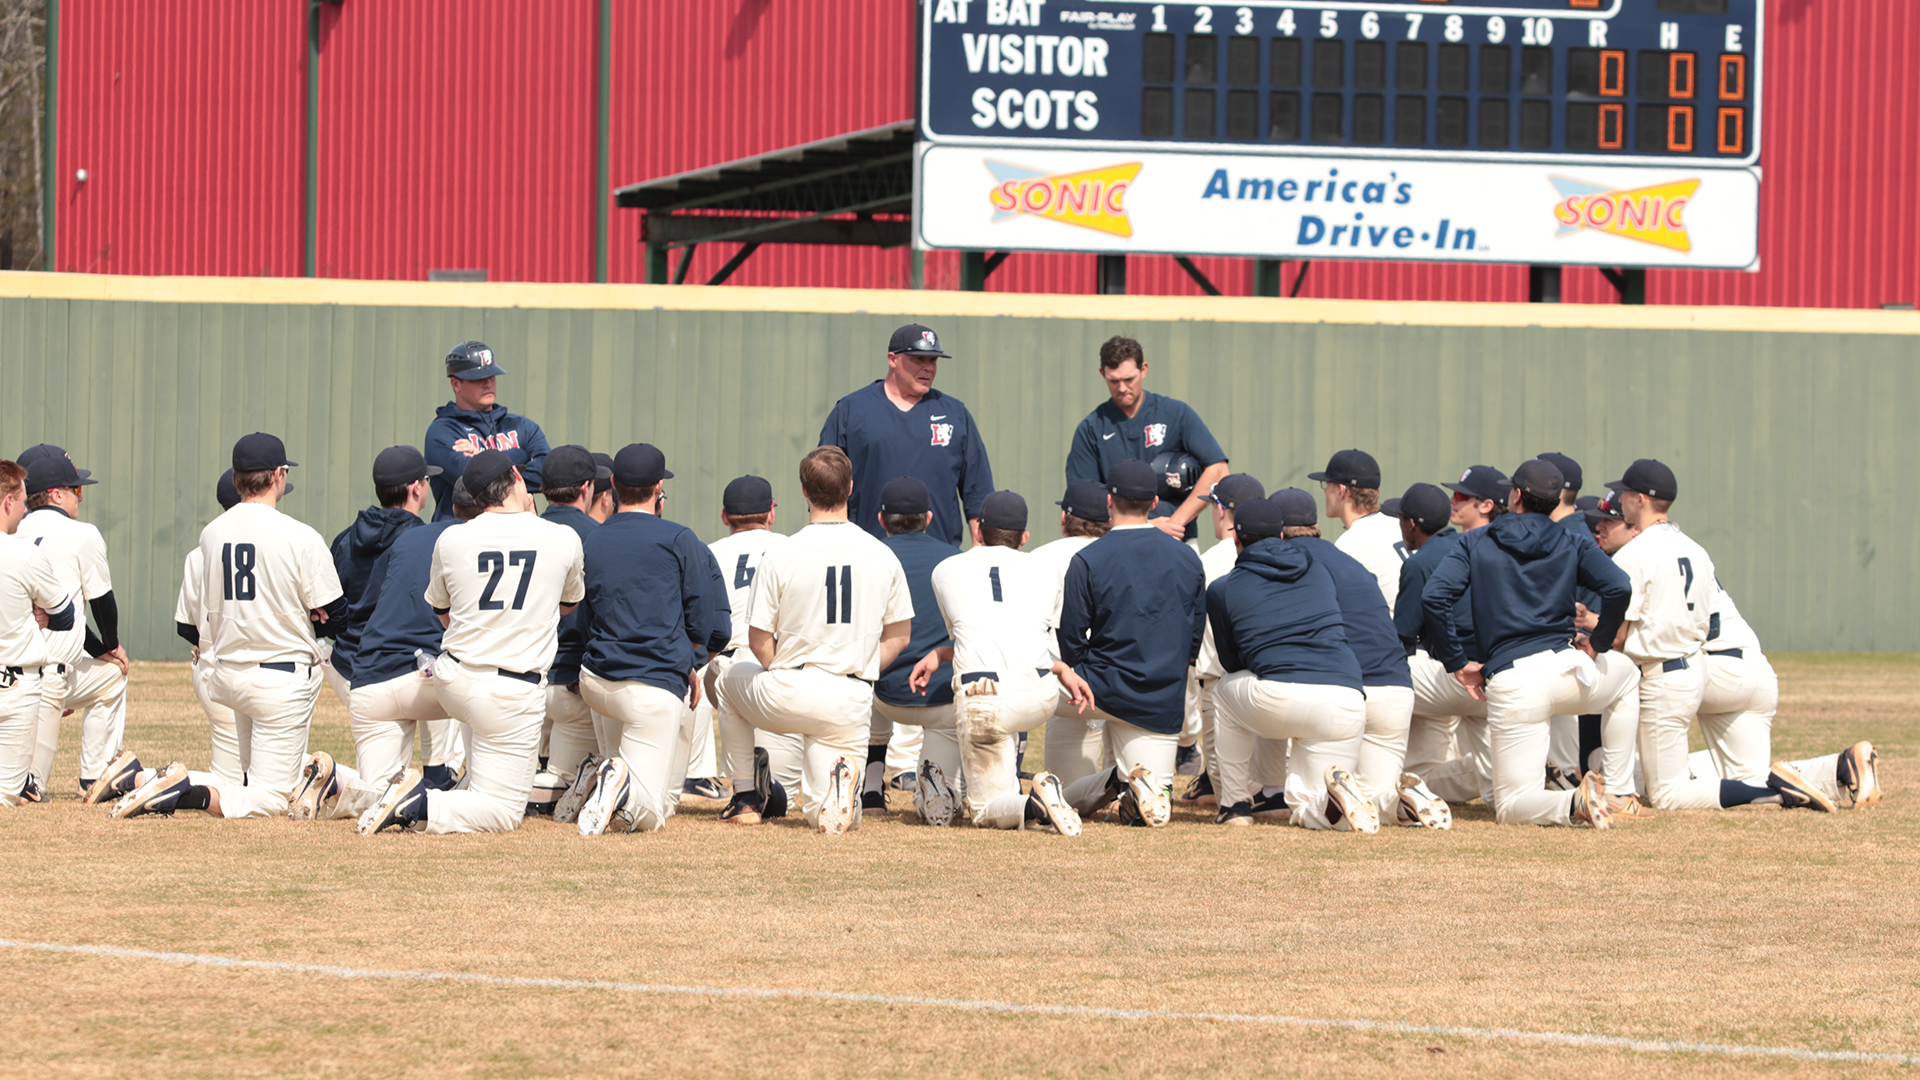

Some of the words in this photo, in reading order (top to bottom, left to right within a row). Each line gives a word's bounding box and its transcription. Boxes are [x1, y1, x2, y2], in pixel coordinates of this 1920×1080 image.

[934, 0, 973, 23] AT
[987, 0, 1046, 26] BAT
[1152, 4, 1167, 32] 1
[1194, 6, 1213, 33] 2
[1235, 7, 1254, 35] 3
[1276, 8, 1296, 36] 4
[1320, 10, 1338, 38] 5
[1361, 12, 1379, 39] 6
[1406, 13, 1423, 40] 7
[1445, 14, 1463, 42] 8
[1487, 15, 1506, 43] 9
[1521, 17, 1553, 45] 10
[1588, 19, 1607, 47] R
[1660, 22, 1678, 49] H
[1725, 24, 1743, 51] E
[962, 33, 1109, 77] VISITOR
[1601, 50, 1624, 96] 0
[1669, 53, 1694, 98] 0
[1720, 55, 1744, 100] 0
[972, 87, 1099, 131] SCOTS
[1599, 104, 1622, 149] 0
[1668, 106, 1693, 151] 0
[1718, 107, 1743, 153] 0
[996, 179, 1131, 216] SONIC
[1201, 168, 1412, 205] America's
[1560, 195, 1690, 232] SONIC
[222, 543, 256, 601] 18
[478, 550, 537, 611] 27
[989, 566, 1003, 602] 1
[1677, 557, 1695, 611] 2
[825, 565, 852, 625] 11
